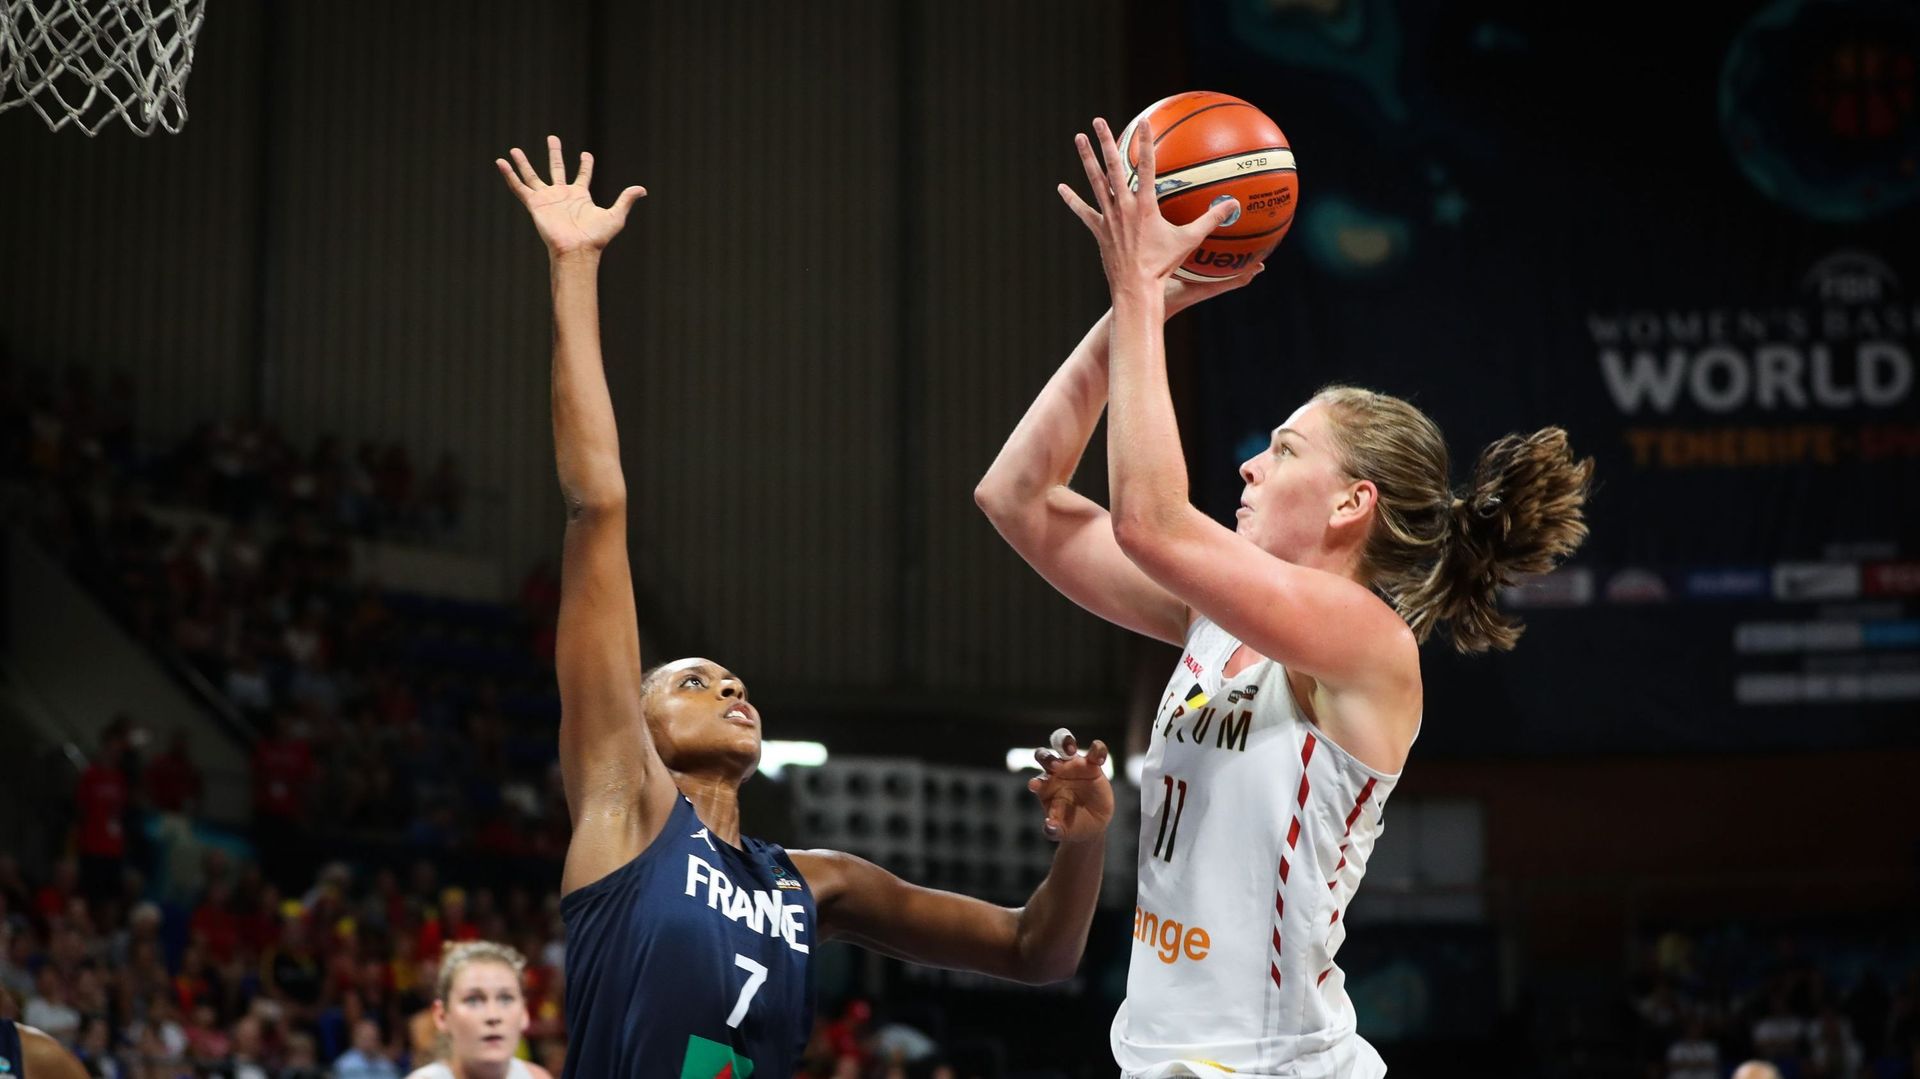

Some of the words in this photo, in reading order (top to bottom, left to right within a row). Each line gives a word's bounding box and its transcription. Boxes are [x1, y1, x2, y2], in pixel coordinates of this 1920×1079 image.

[1237, 158, 1267, 171] GL6X
[1246, 201, 1265, 211] CUP
[1267, 193, 1291, 208] WORLD
[1599, 341, 1915, 414] WORLD
[1625, 425, 1839, 468] TENERIFE
[1154, 775, 1187, 863] 11
[684, 854, 809, 955] FRANCE
[726, 953, 768, 1030] 7
